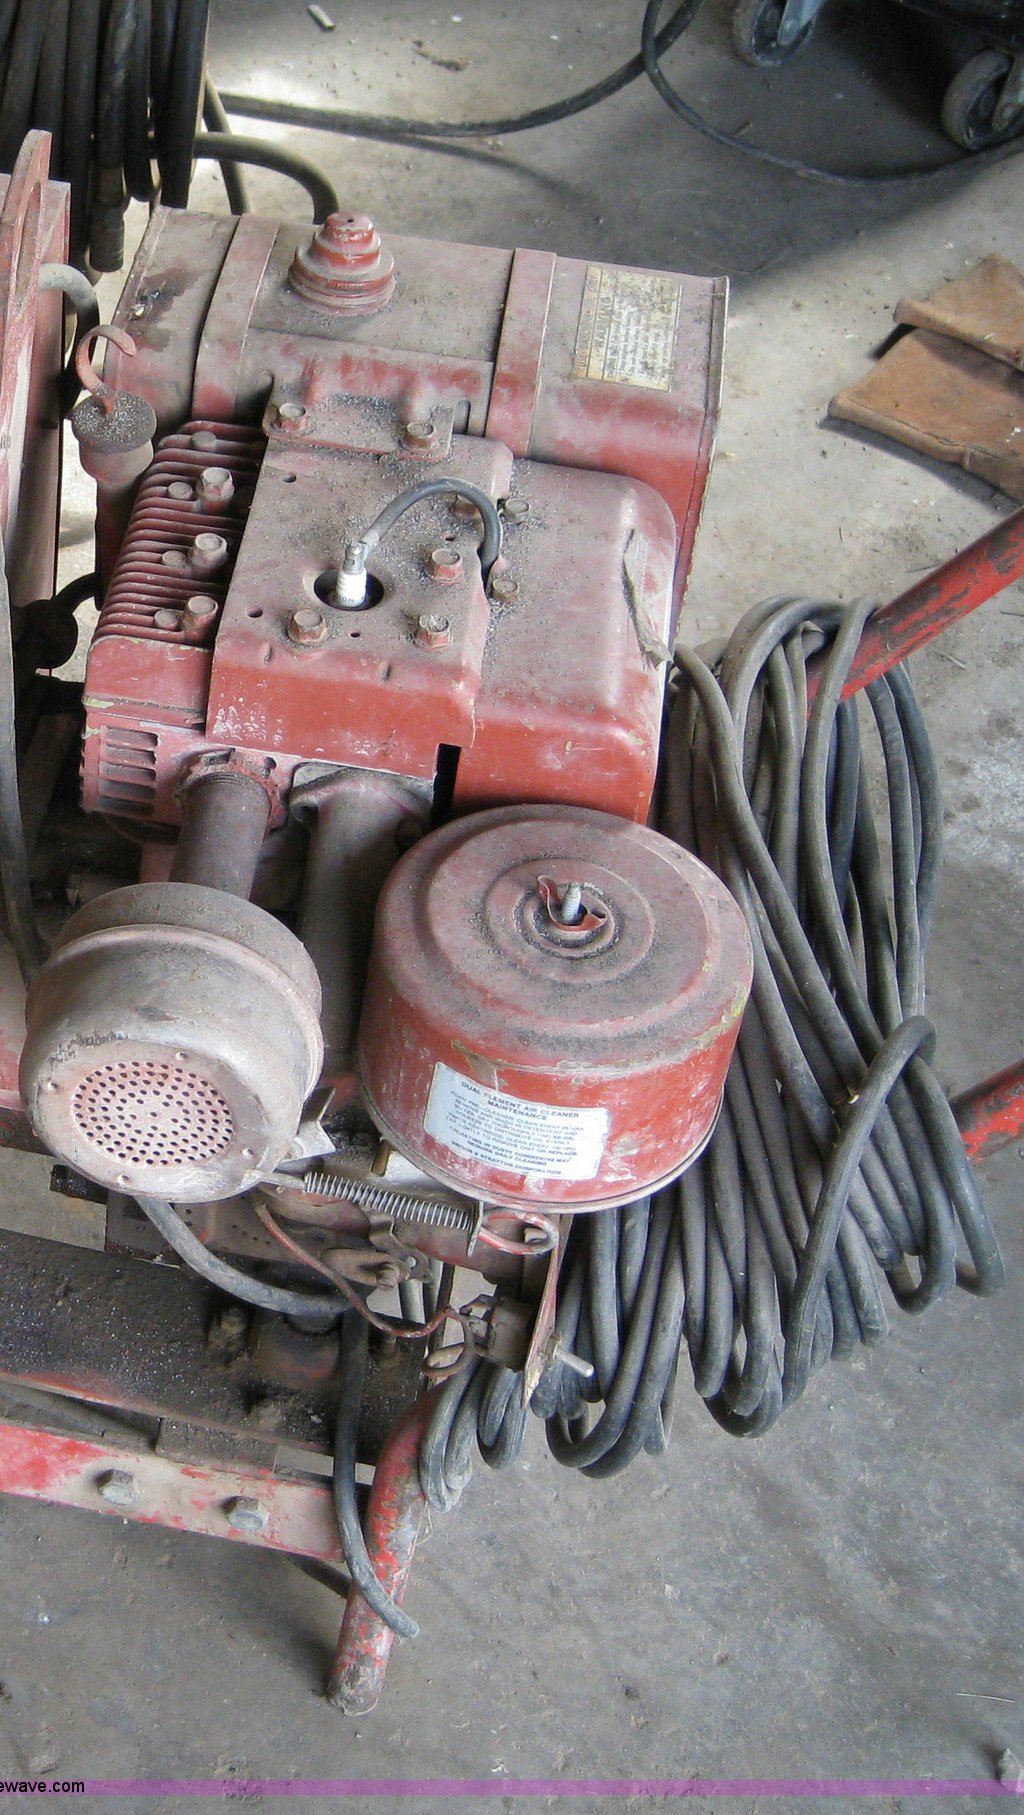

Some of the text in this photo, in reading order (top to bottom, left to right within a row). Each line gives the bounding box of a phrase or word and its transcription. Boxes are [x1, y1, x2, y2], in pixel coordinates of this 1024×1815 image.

[461, 1081, 481, 1095] DUAL
[524, 1105, 537, 1113] AIR
[541, 1108, 579, 1118] CLEANER
[488, 1100, 547, 1120] MAINTENANCE
